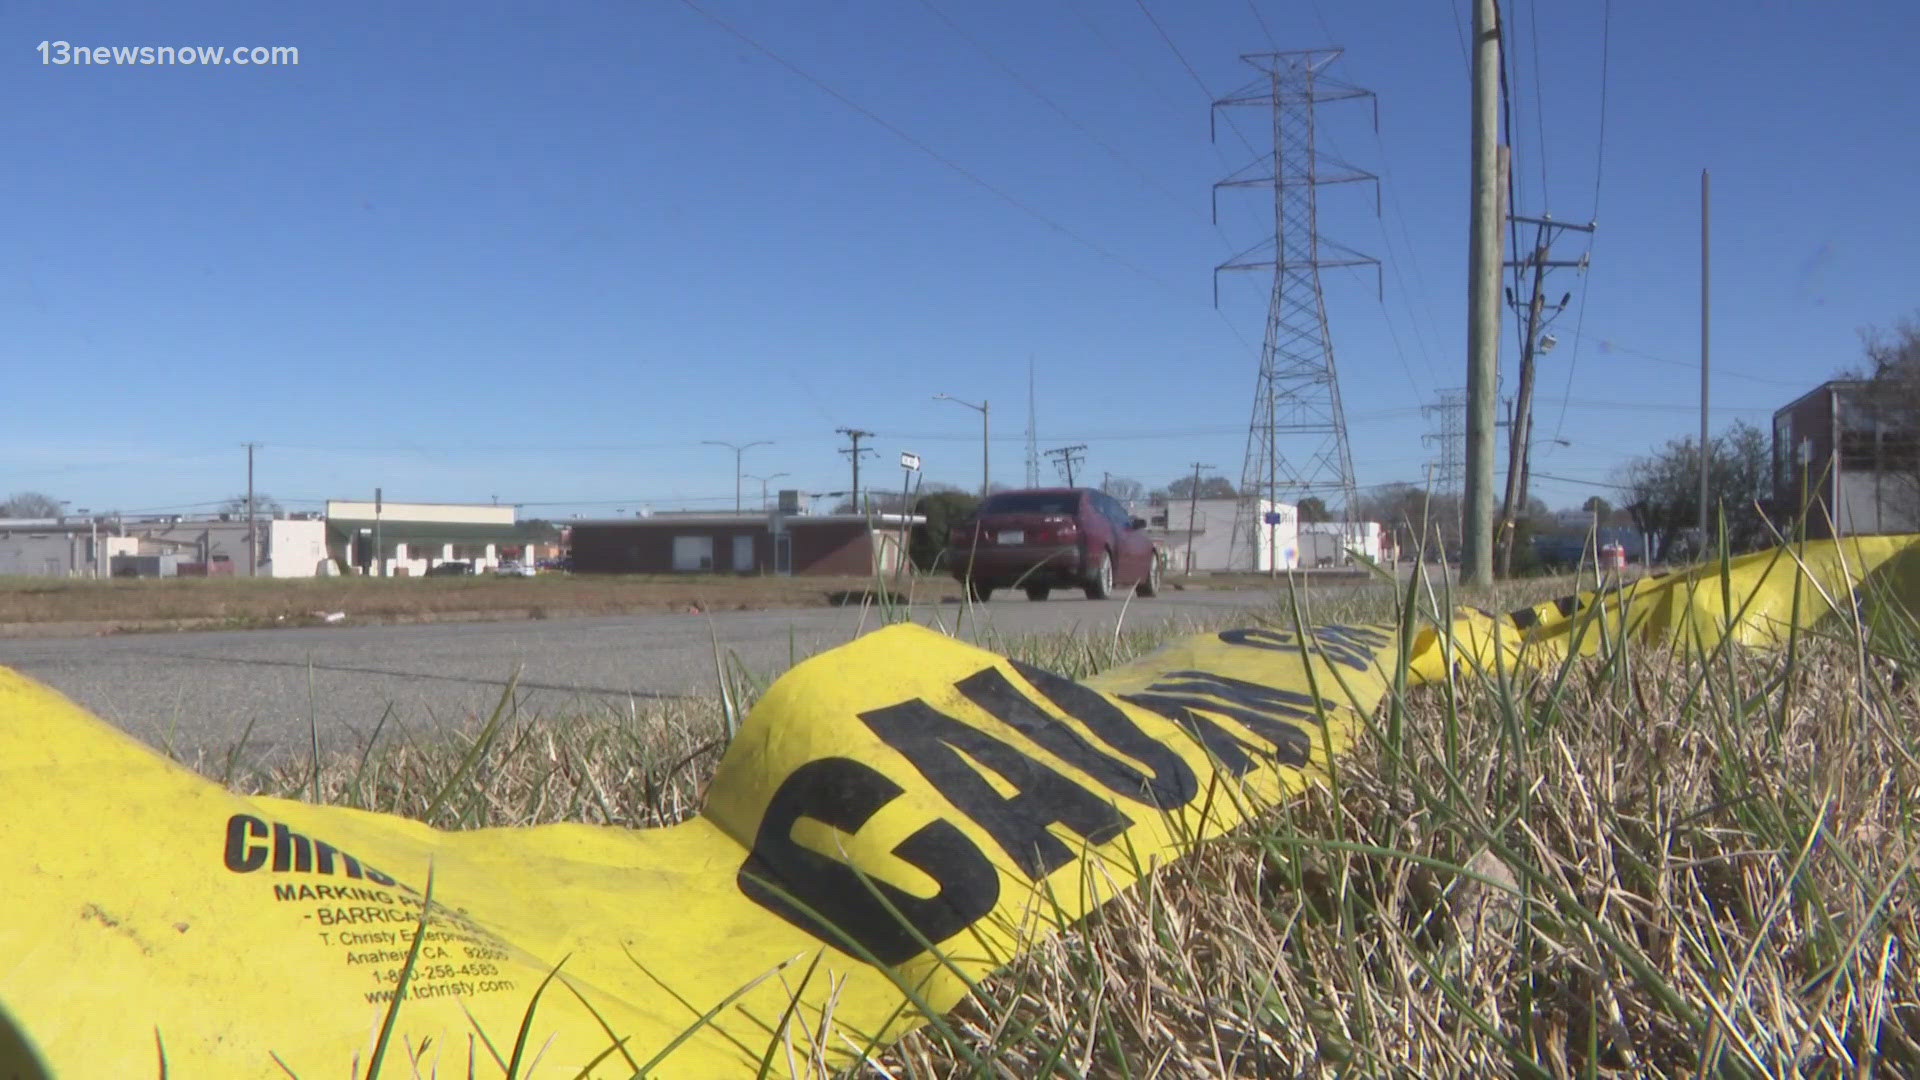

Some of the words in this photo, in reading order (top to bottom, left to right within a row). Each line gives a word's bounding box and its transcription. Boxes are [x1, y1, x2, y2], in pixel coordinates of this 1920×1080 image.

[274, 883, 394, 905] MARKING
[339, 931, 396, 946] Christy
[346, 948, 418, 966] Anahei
[364, 979, 515, 1004] ww.tchristy.com
